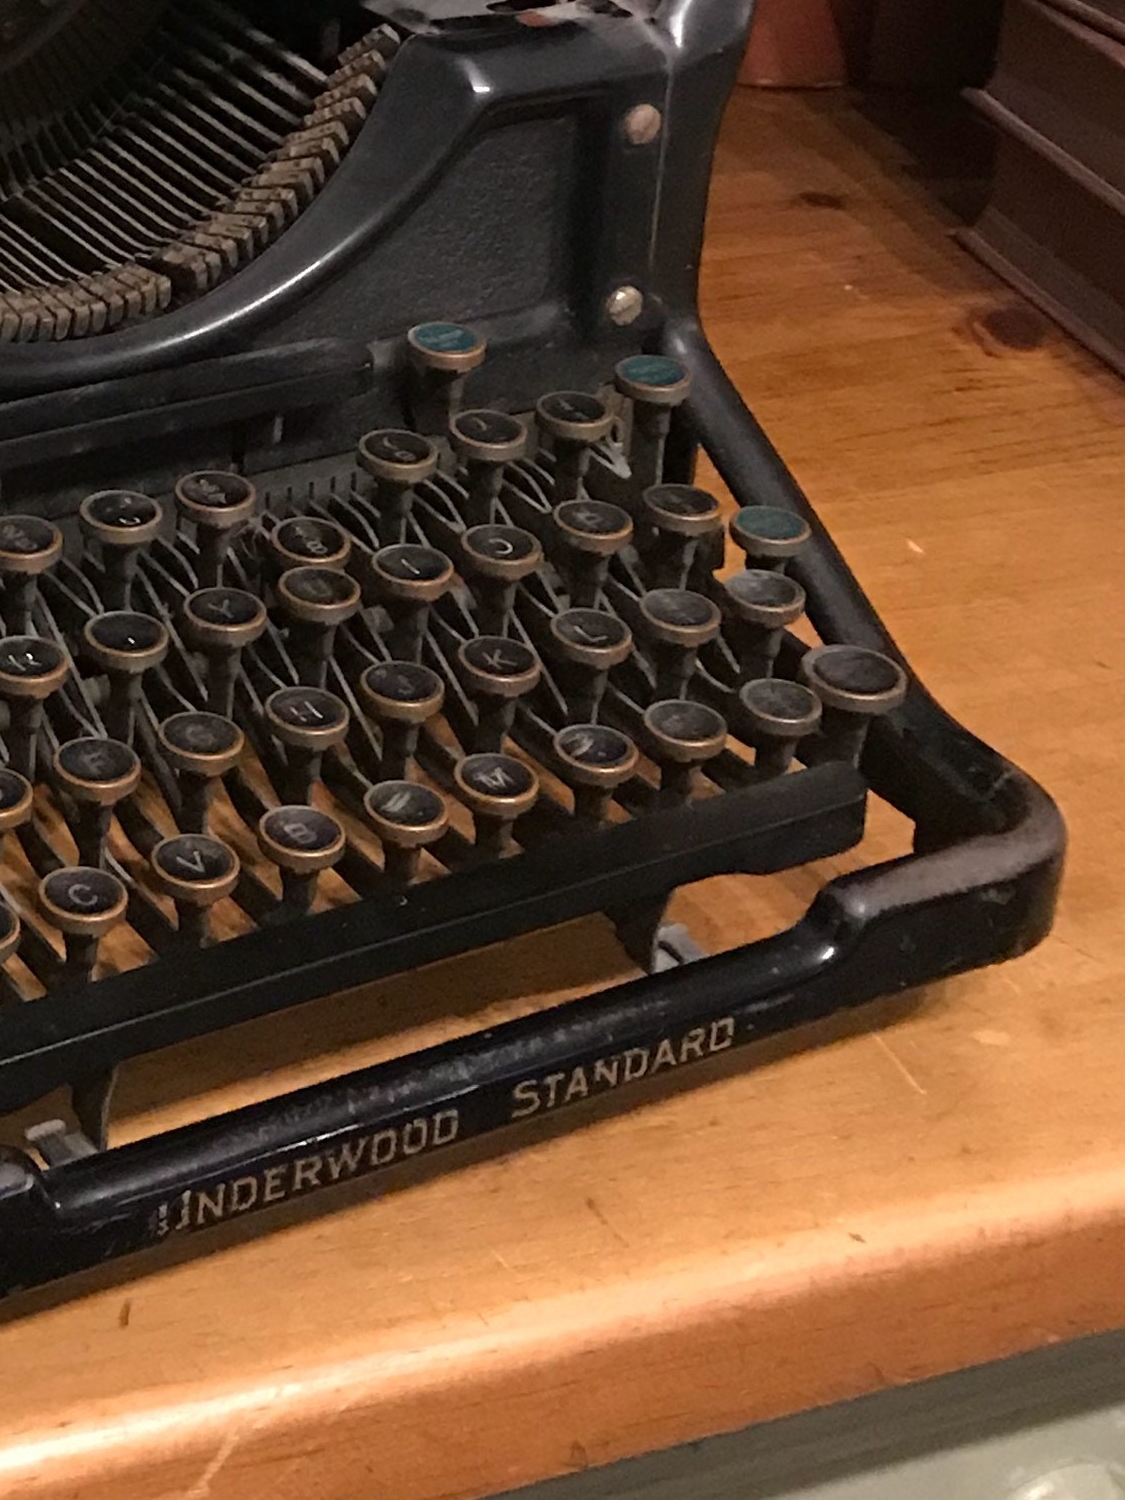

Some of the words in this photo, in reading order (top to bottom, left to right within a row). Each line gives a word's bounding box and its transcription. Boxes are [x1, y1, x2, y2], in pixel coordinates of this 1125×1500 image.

[481, 648, 516, 670] K
[175, 850, 206, 874] V
[67, 882, 99, 907] C
[151, 1108, 460, 1237] UNDERWOOD
[511, 1016, 735, 1118] STANDARD
